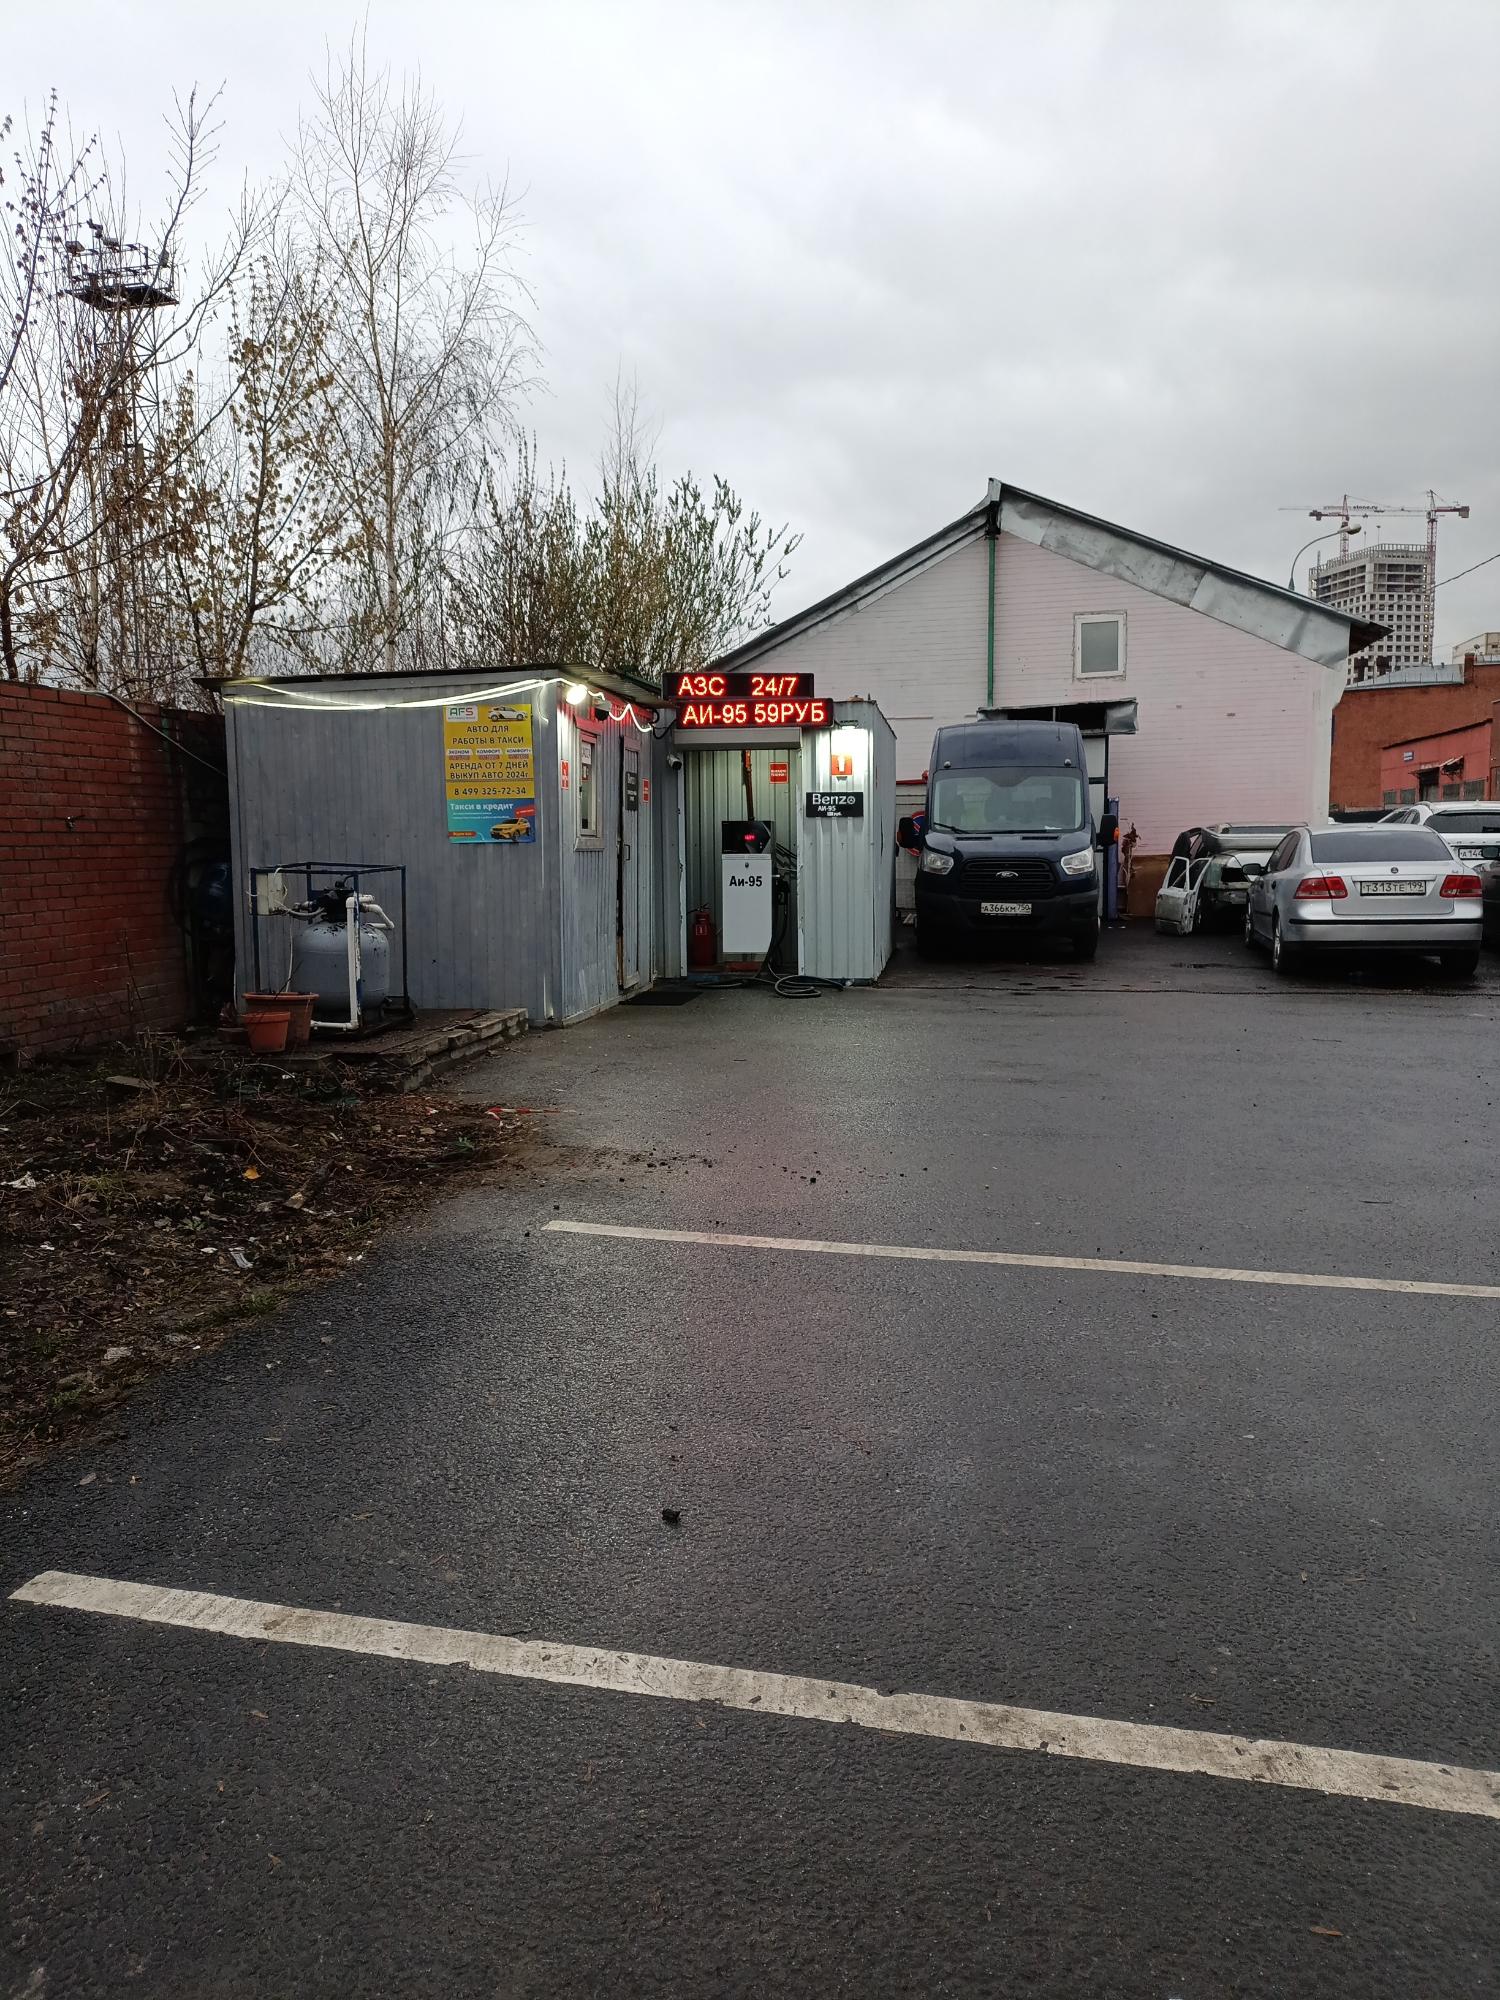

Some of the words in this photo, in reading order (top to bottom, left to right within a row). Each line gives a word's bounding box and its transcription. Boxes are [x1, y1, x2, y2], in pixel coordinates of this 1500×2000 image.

[678, 676, 725, 696] АЗС
[751, 676, 797, 696] 24/7
[450, 707, 473, 716] AFS
[683, 704, 747, 725] АИ-95
[754, 702, 824, 723] 59РУБ
[491, 725, 509, 733] ДЛЯ
[452, 737, 487, 745] РАБОТЫ
[498, 736, 524, 744] ТАКСИ
[449, 762, 482, 770] АРЕНДА
[506, 760, 528, 769] ДНЕЙ
[481, 787, 526, 795] 325-72-34
[729, 875, 763, 887] Аи-95
